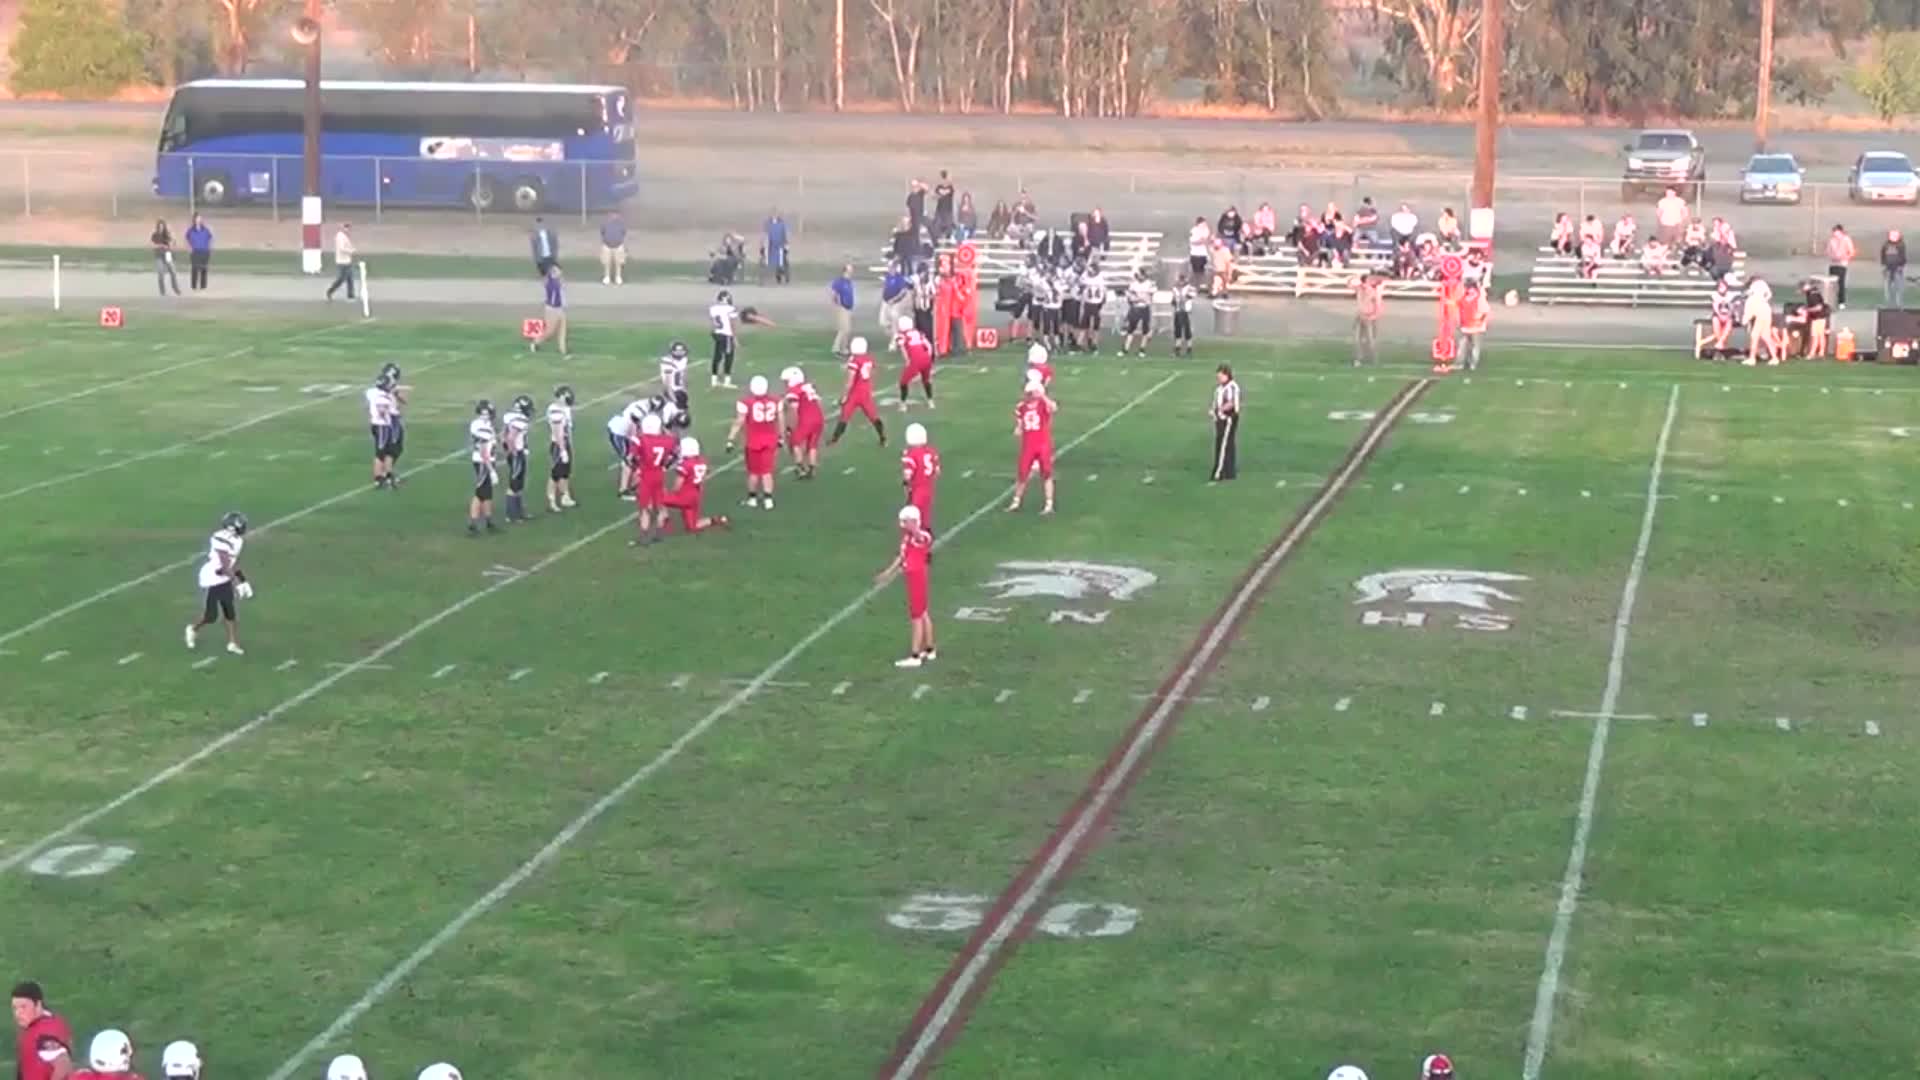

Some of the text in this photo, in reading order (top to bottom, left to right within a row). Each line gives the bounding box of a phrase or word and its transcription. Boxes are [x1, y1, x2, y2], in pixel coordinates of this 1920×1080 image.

[103, 310, 119, 323] 20
[980, 330, 996, 345] 40
[752, 401, 777, 423] 62
[652, 446, 665, 467] 7
[923, 452, 933, 476] 5
[885, 892, 1142, 937] 50
